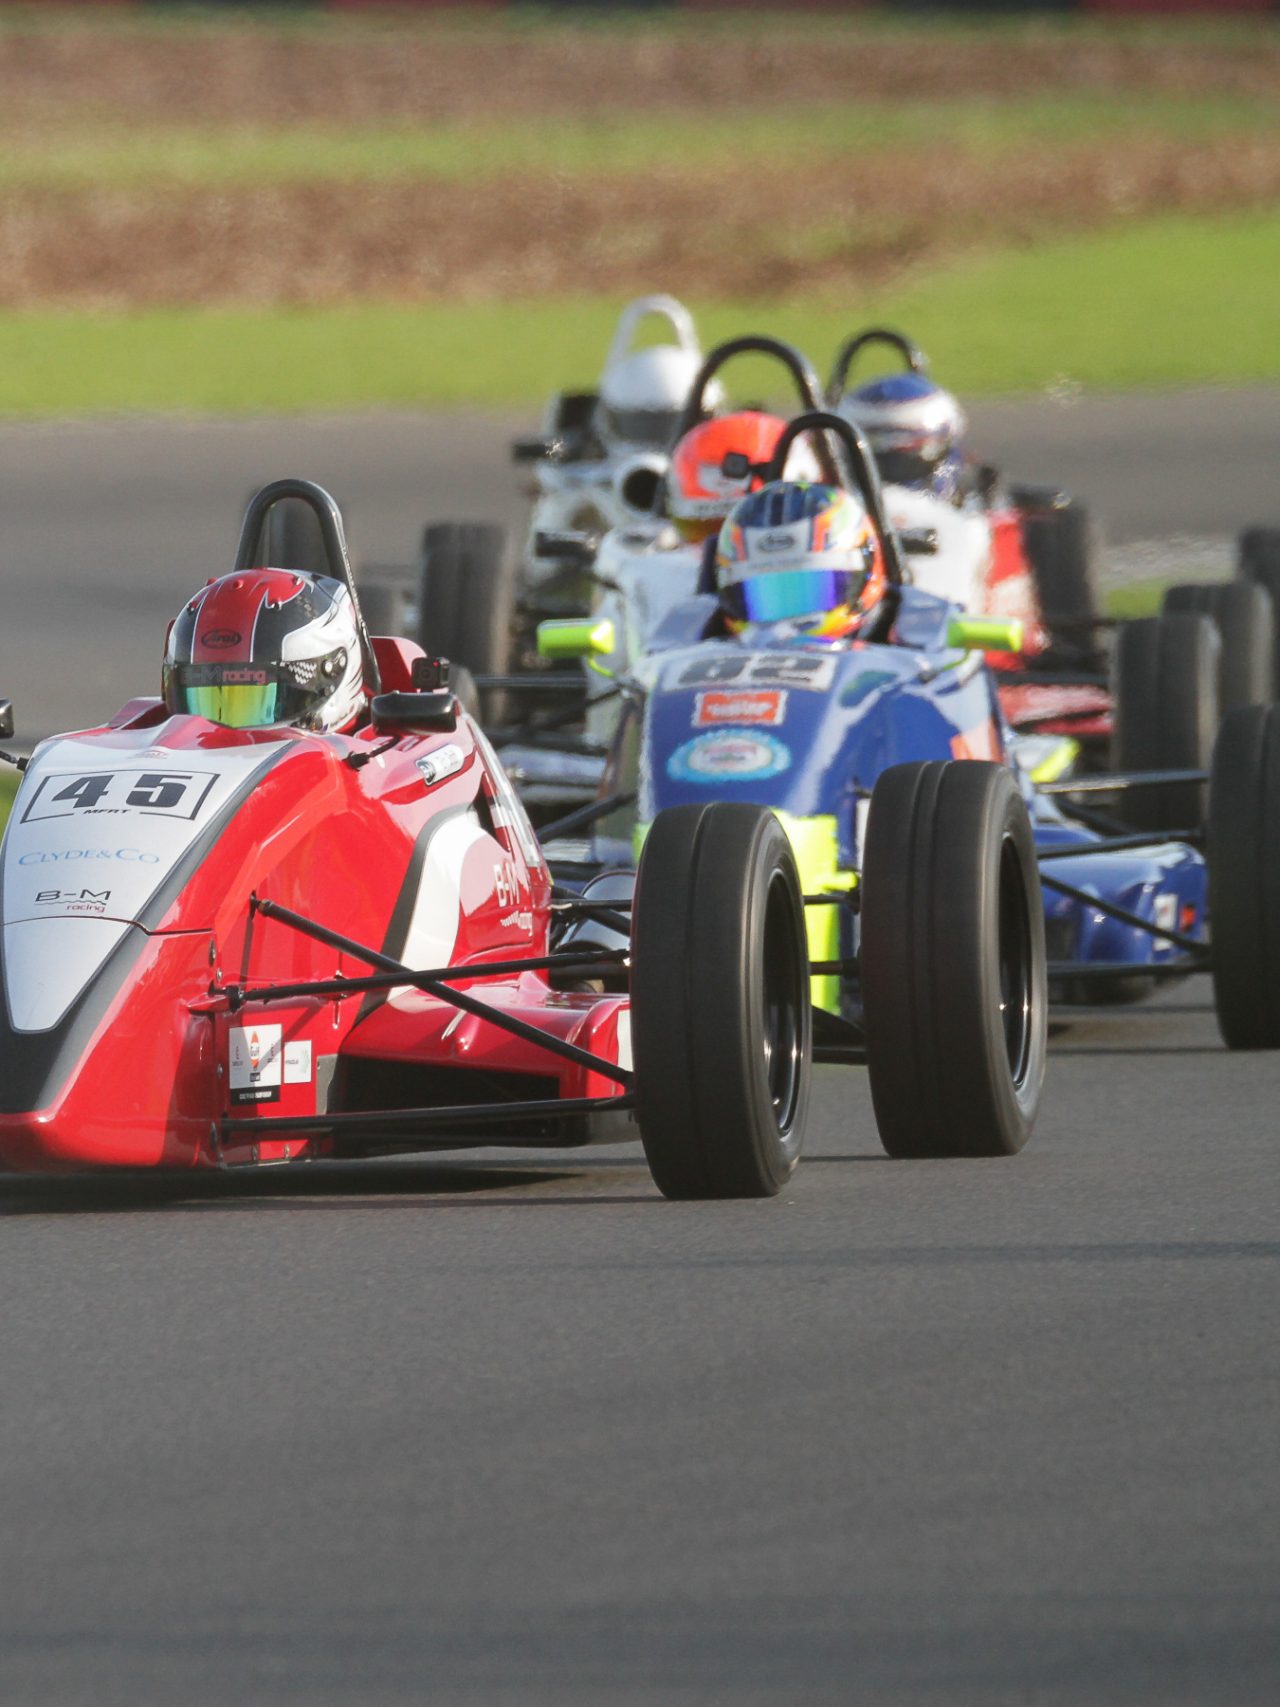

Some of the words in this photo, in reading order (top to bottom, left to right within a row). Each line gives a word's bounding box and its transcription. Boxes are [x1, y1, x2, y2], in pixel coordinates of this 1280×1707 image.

[223, 668, 267, 686] racing
[52, 774, 193, 808] 45
[35, 889, 111, 902] B-M
[66, 904, 106, 912] racing
